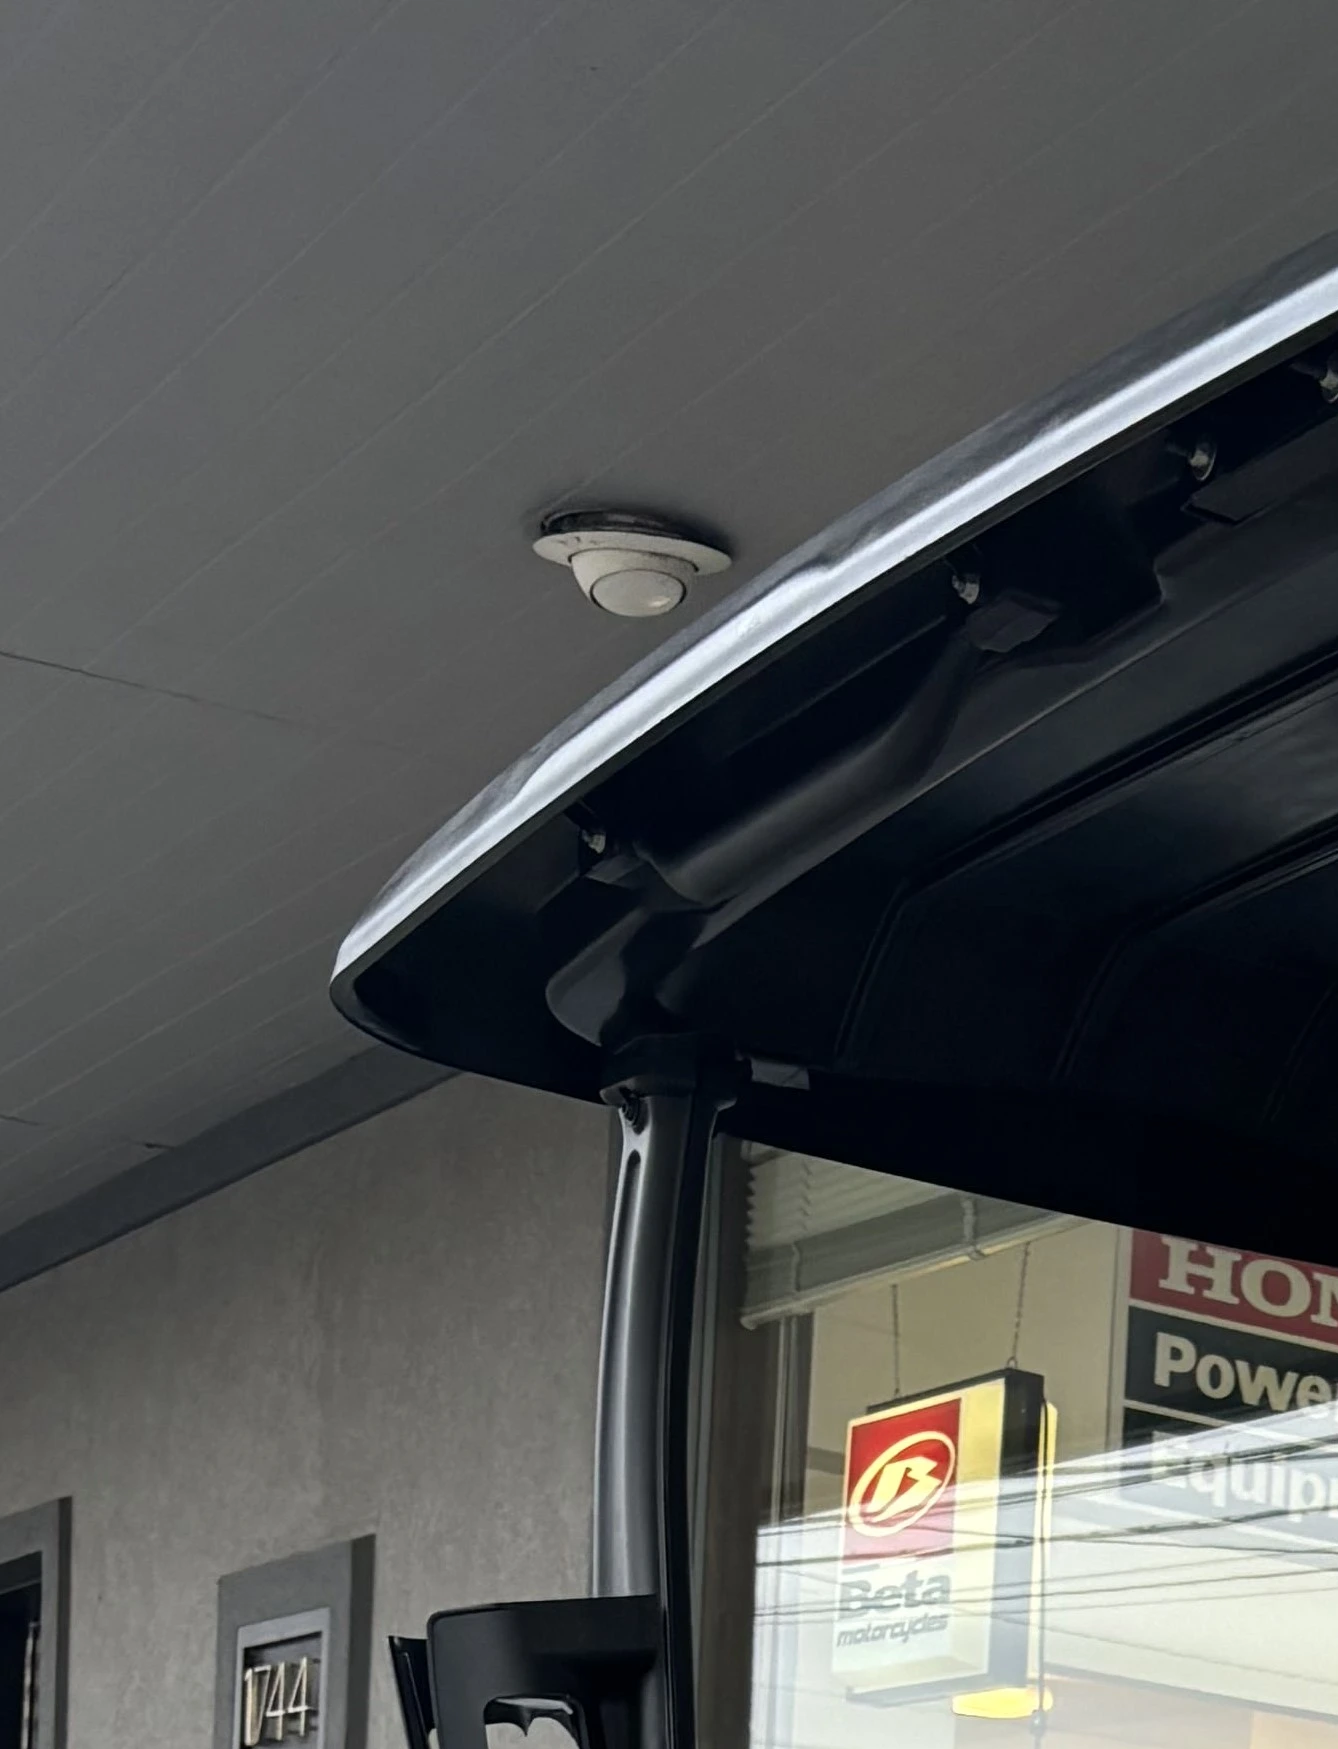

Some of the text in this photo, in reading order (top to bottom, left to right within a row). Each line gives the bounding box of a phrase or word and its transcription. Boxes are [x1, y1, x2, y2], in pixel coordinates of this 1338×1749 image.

[837, 1570, 952, 1619] Beta
[836, 1612, 950, 1648] motorcycles
[244, 1655, 309, 1747] 1744
